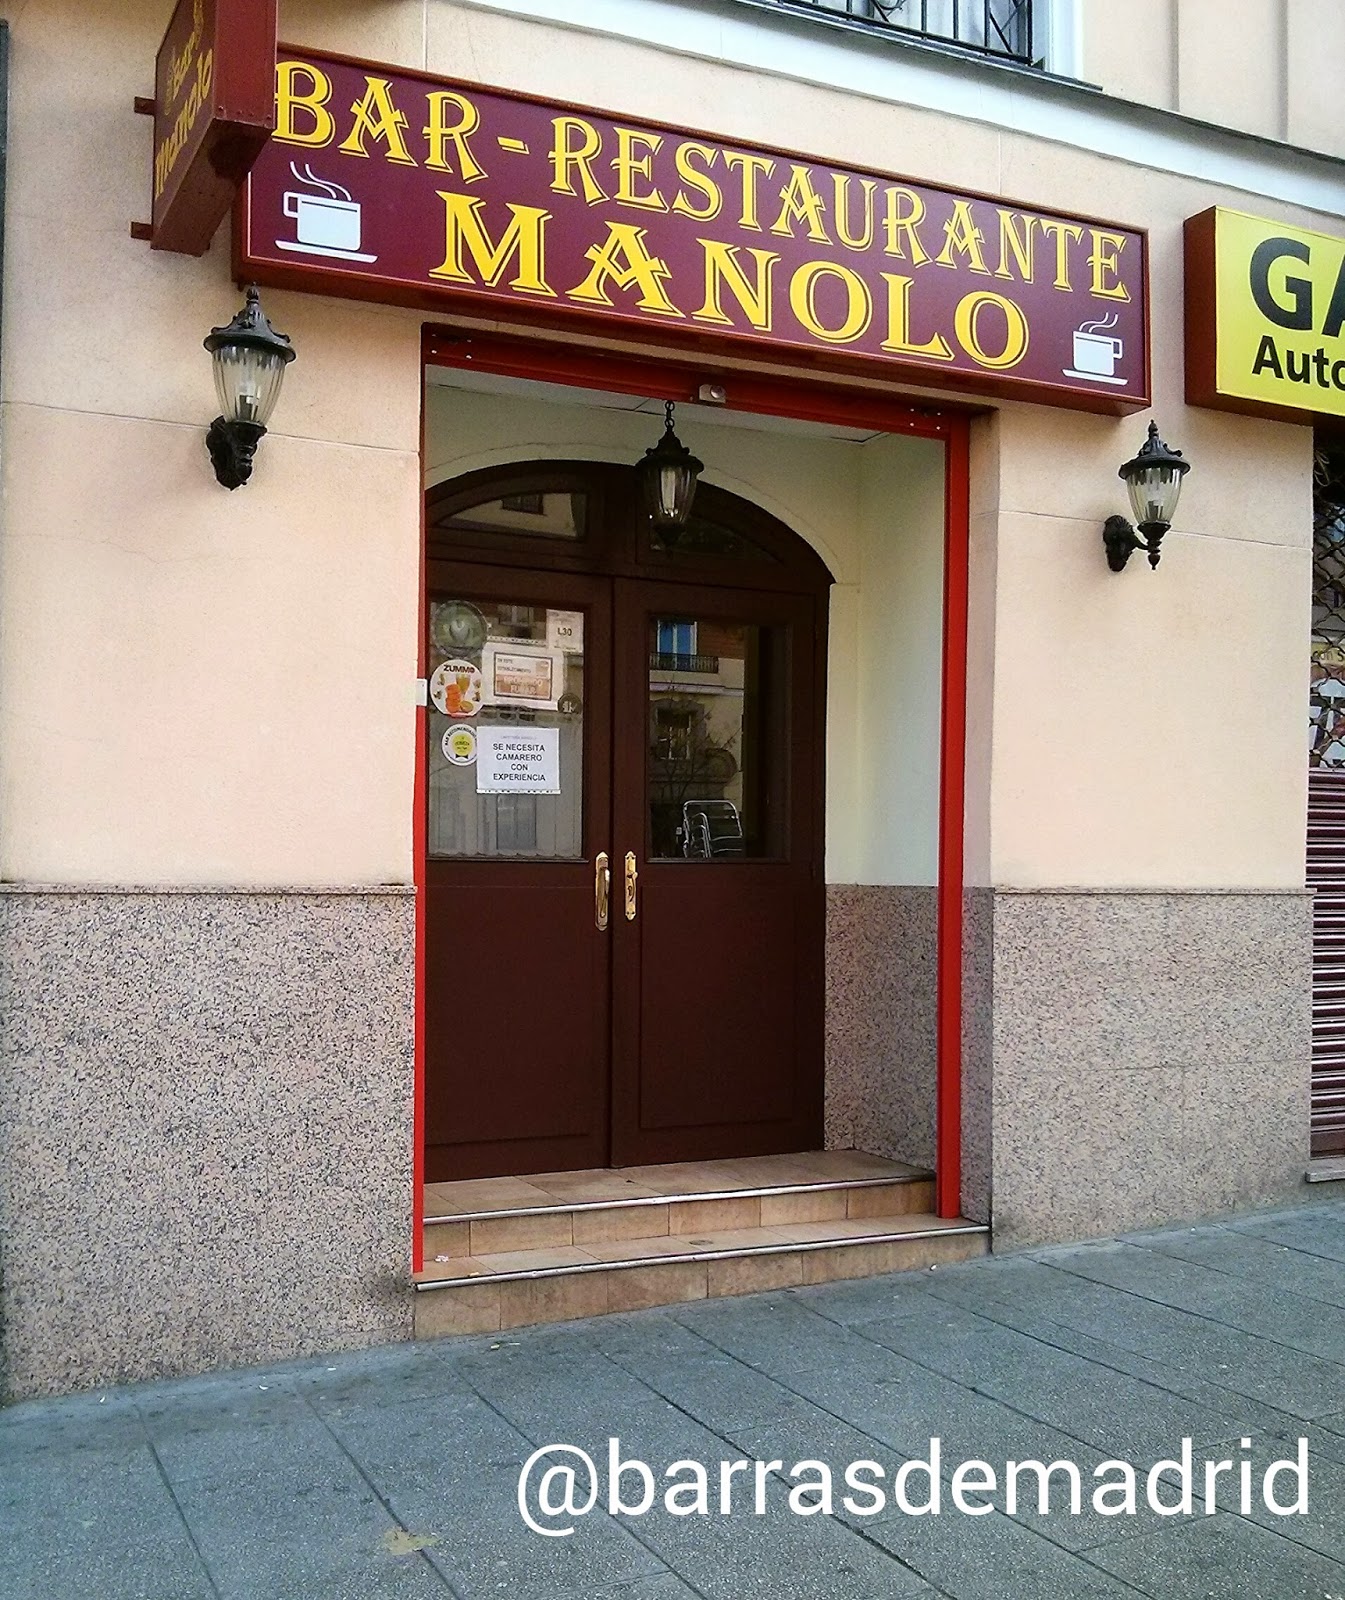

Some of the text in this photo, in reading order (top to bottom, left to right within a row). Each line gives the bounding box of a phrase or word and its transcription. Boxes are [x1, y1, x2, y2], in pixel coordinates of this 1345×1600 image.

[428, 190, 1030, 370] MANOLO
[493, 743, 546, 752] SE NECESITA
[496, 753, 543, 762] CAMARERO
[511, 763, 529, 771] CON
[493, 773, 546, 781] EXPERIENCIA
